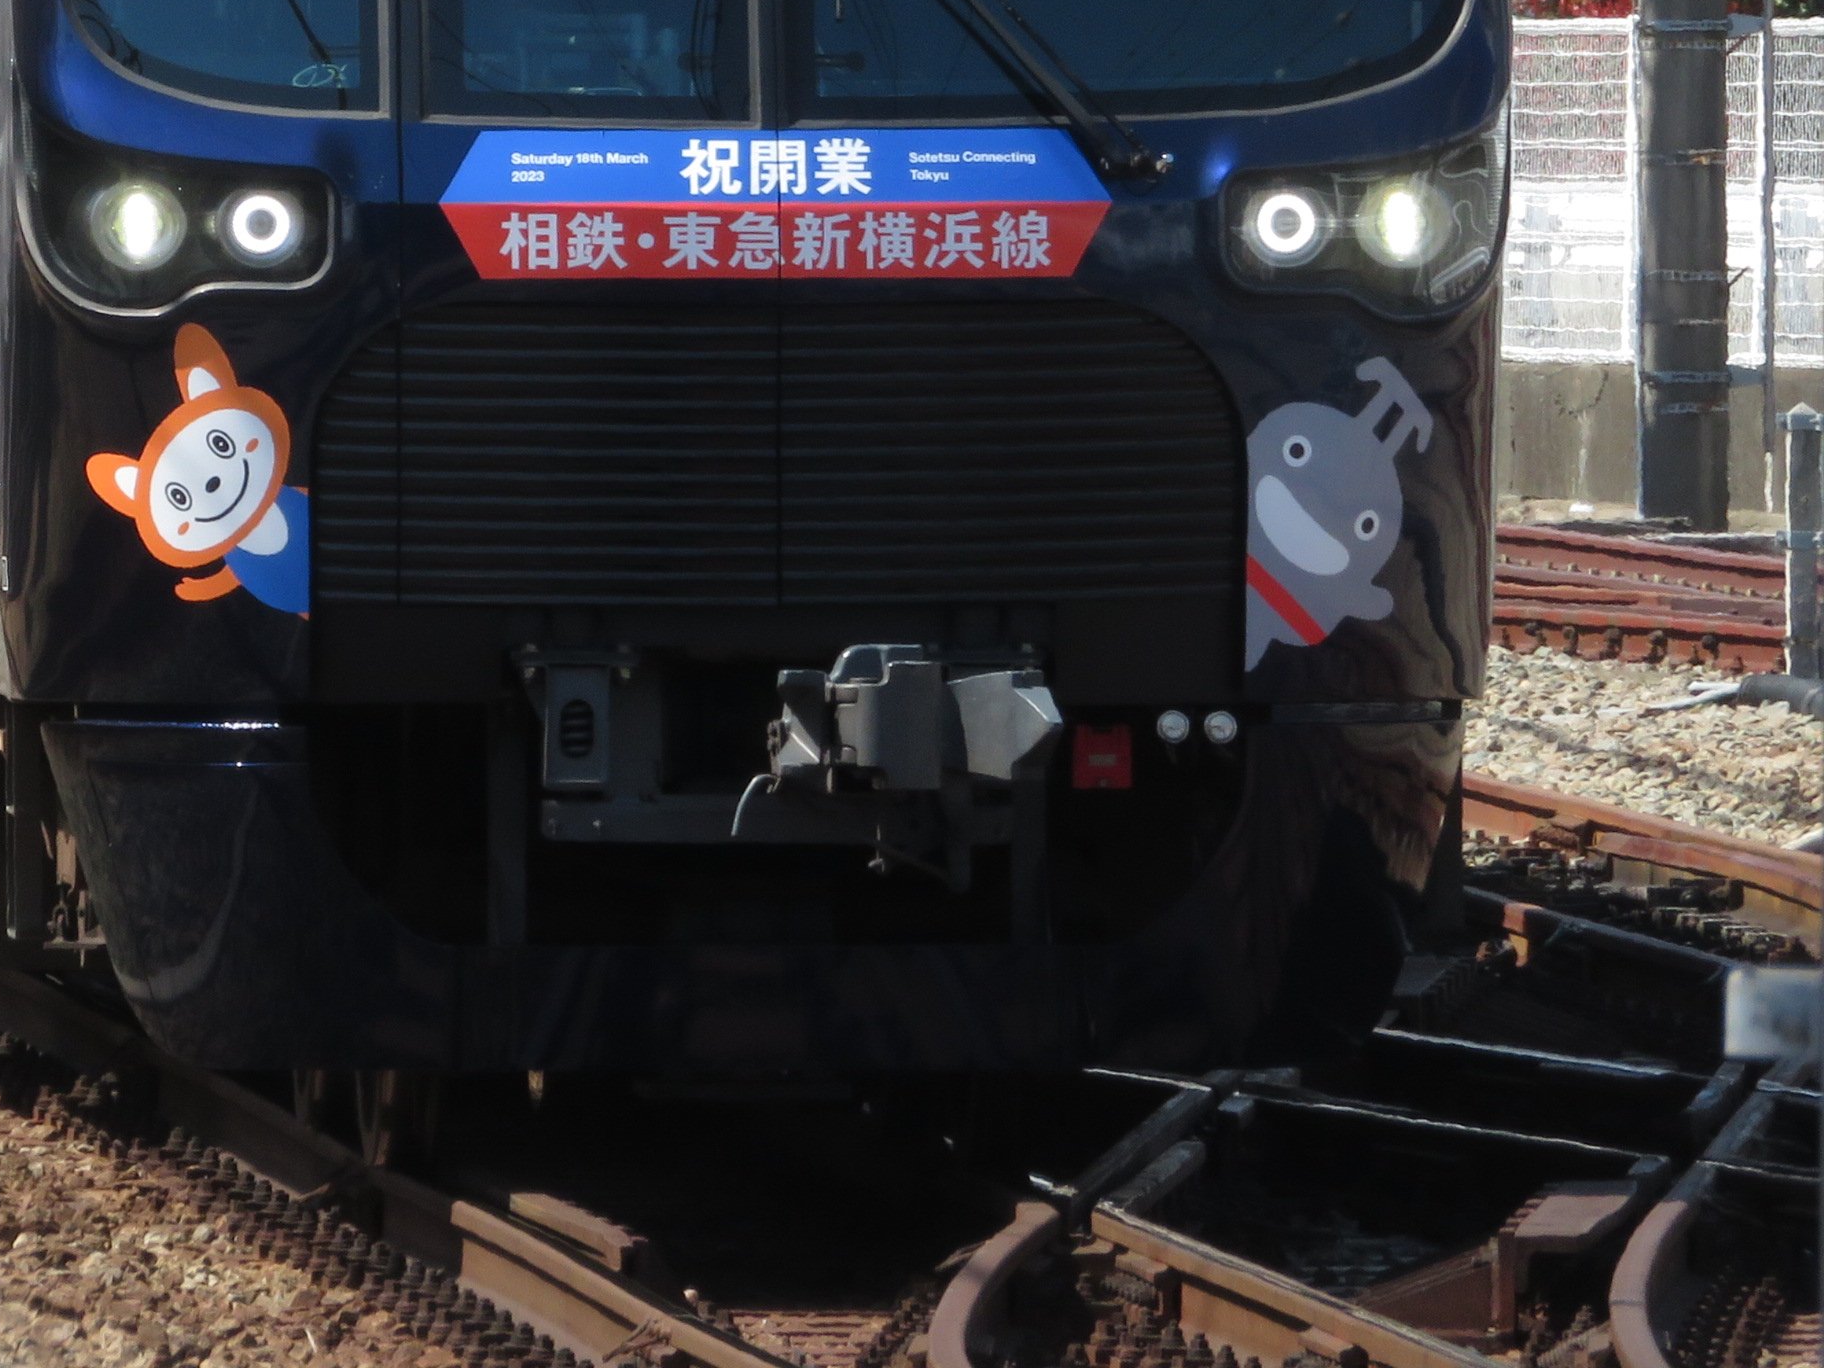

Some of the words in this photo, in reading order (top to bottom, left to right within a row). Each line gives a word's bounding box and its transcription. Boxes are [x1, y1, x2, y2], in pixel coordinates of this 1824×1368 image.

[510, 152, 573, 167] Saturday
[575, 153, 604, 165] 18th
[606, 152, 649, 165] March
[908, 151, 960, 164] Sotetsu
[961, 150, 1037, 165] Connecting
[678, 137, 873, 196] 祝開業
[510, 170, 545, 183] 2023
[909, 169, 950, 183] Tokyu
